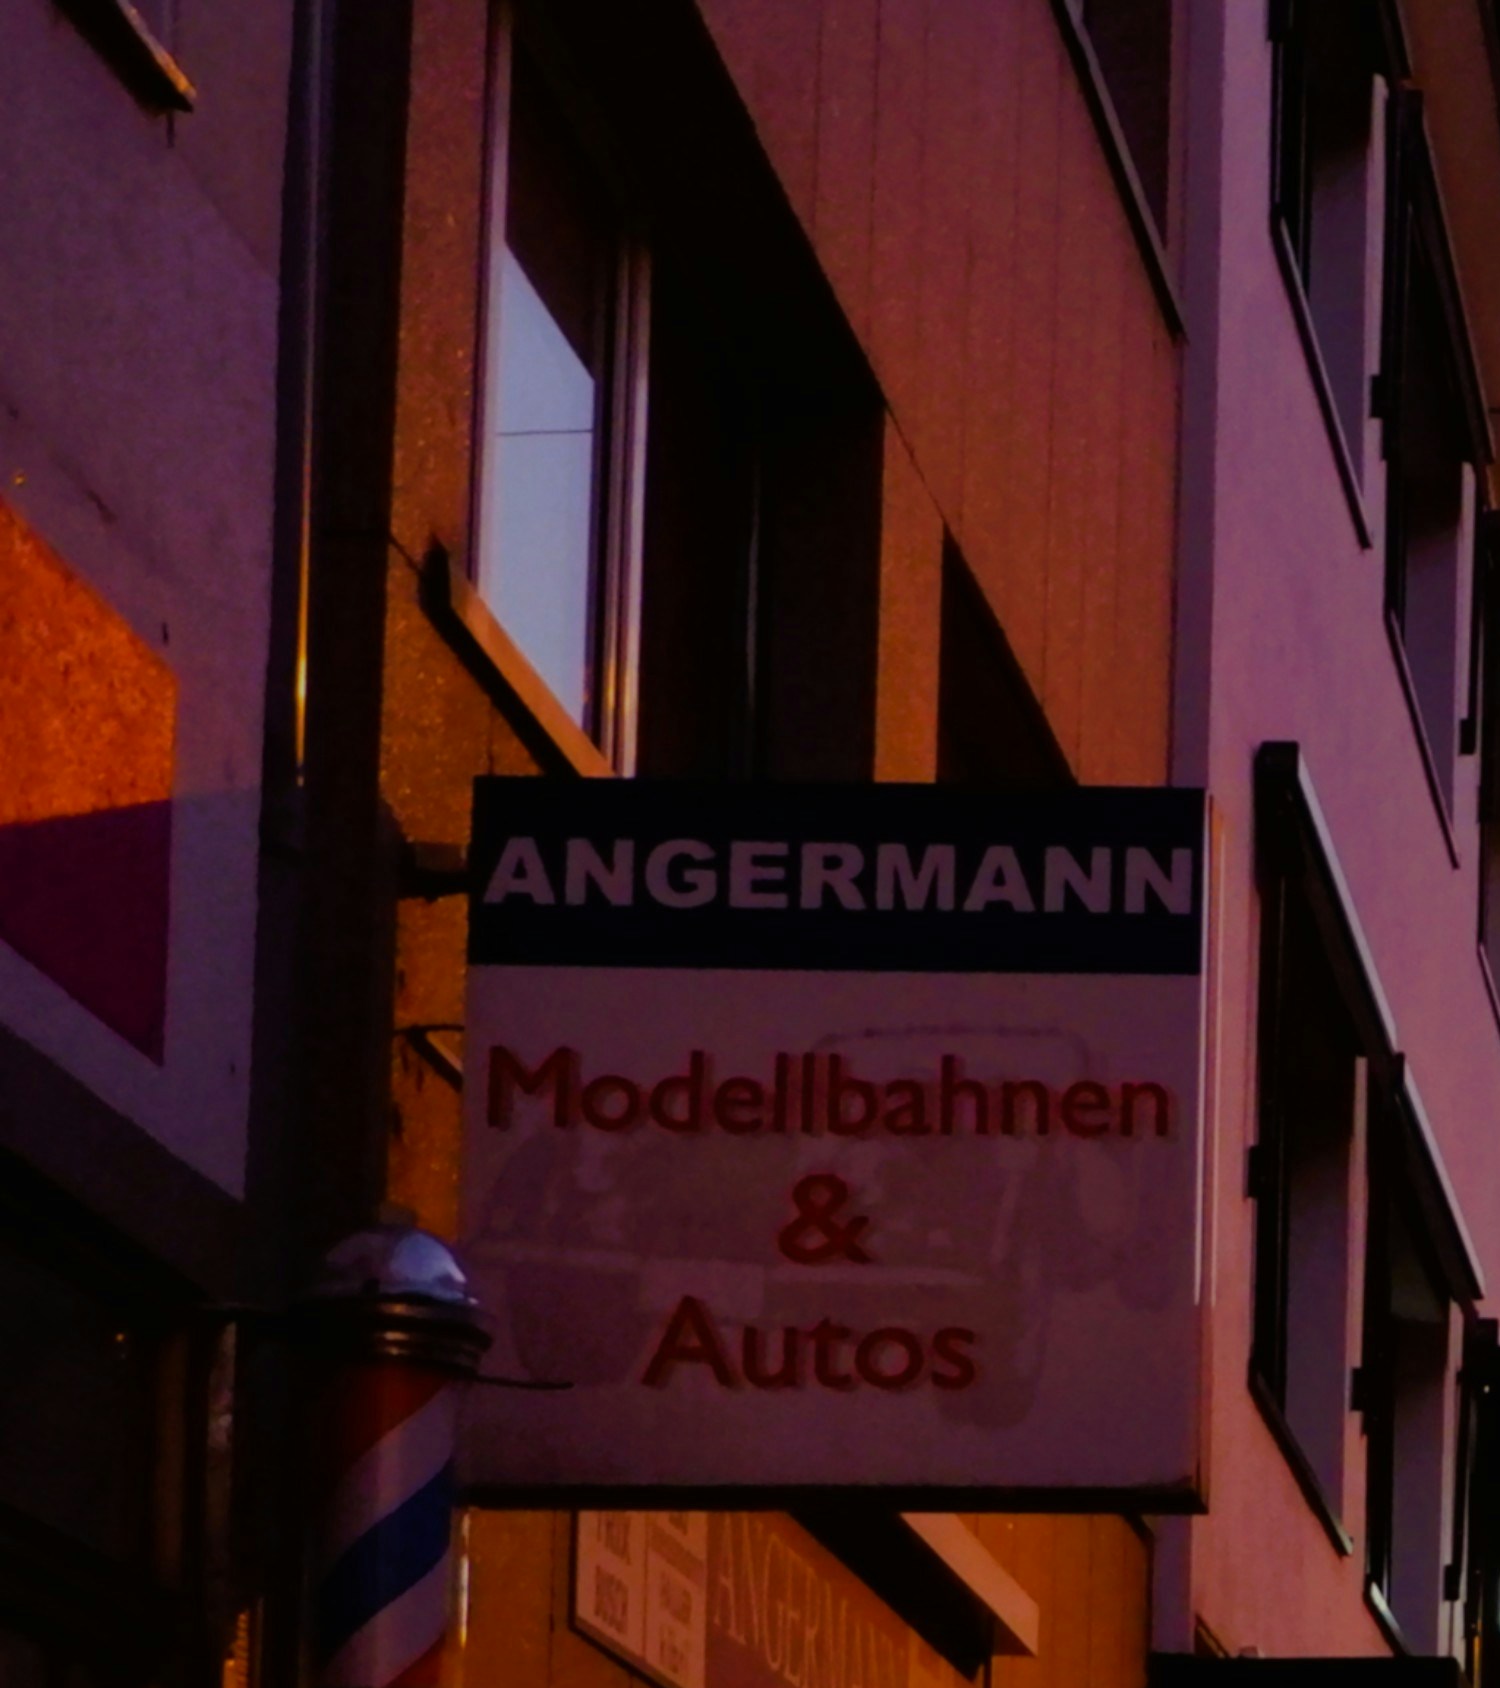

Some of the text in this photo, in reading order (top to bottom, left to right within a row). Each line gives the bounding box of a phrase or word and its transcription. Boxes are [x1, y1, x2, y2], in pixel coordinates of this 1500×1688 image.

[483, 836, 1193, 916] ANGERMANN
[486, 1046, 1169, 1137] Modellbahnen
[778, 1174, 871, 1265] &
[641, 1296, 977, 1391] Autos
